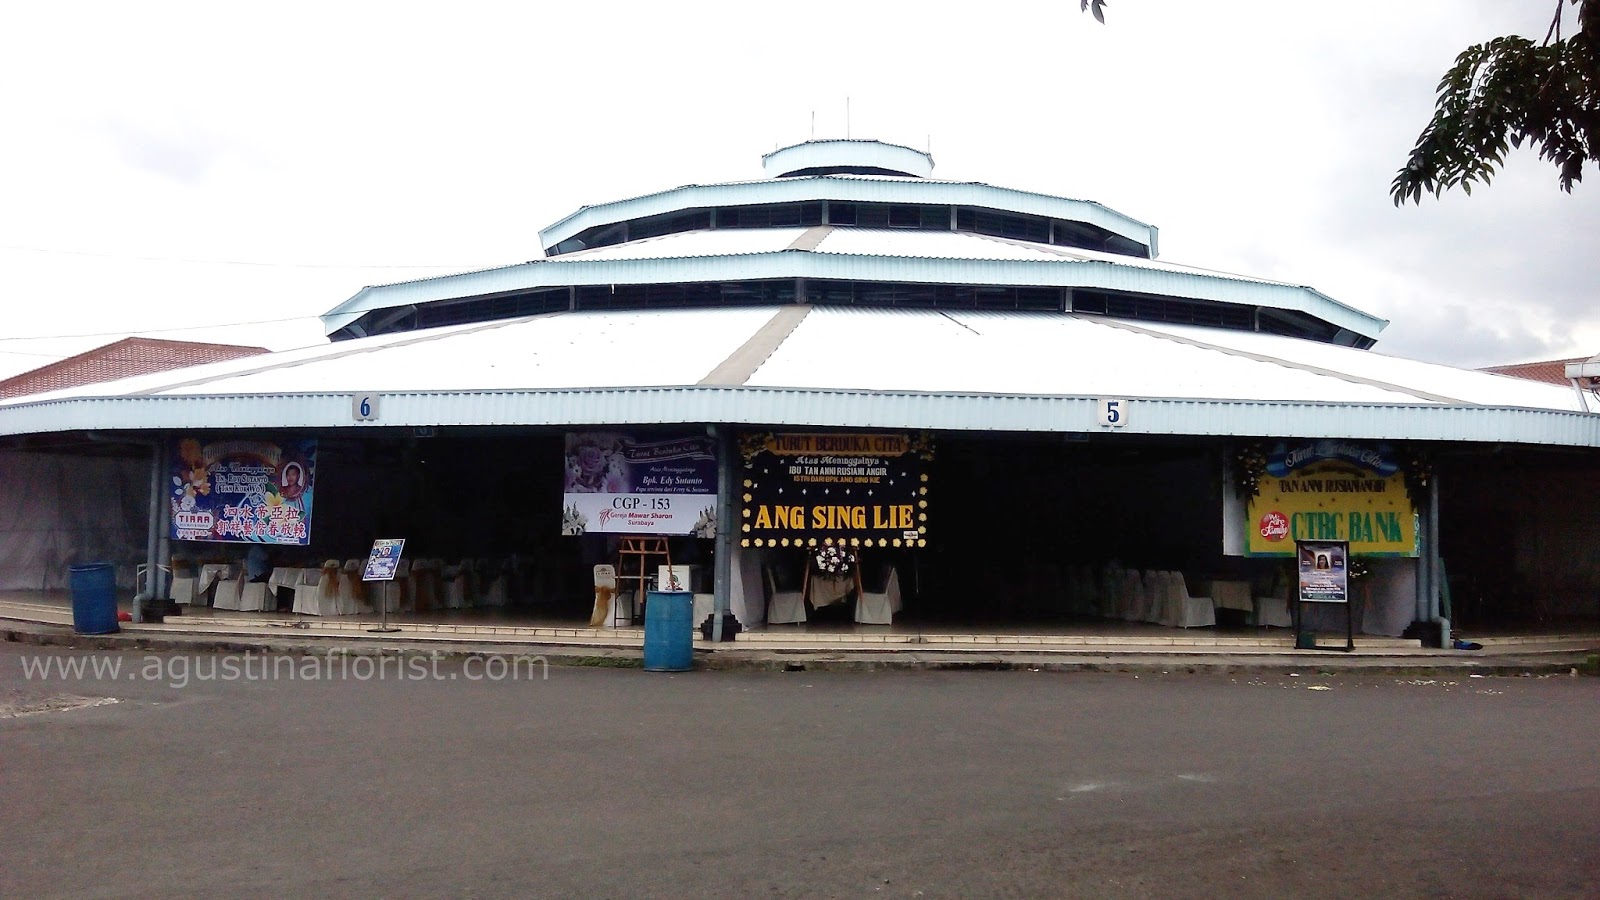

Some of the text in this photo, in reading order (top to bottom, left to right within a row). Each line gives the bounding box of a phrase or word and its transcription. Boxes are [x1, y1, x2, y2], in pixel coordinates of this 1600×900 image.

[360, 396, 371, 417] 6
[1107, 401, 1120, 423] 5
[775, 437, 901, 451] TURUT BERDUKA CITA
[795, 456, 819, 465] Atas
[789, 466, 802, 475] IBU
[804, 466, 818, 475] TAN
[819, 467, 837, 475] ANNI
[866, 468, 888, 476] ANGIR
[660, 476, 674, 486] Edy
[612, 497, 640, 510] CGP
[651, 498, 671, 510] 153
[178, 515, 210, 524] TIARA
[628, 519, 655, 527] Surabaya
[754, 505, 914, 530] ANG SING LIE
[1348, 512, 1403, 542] BANK
